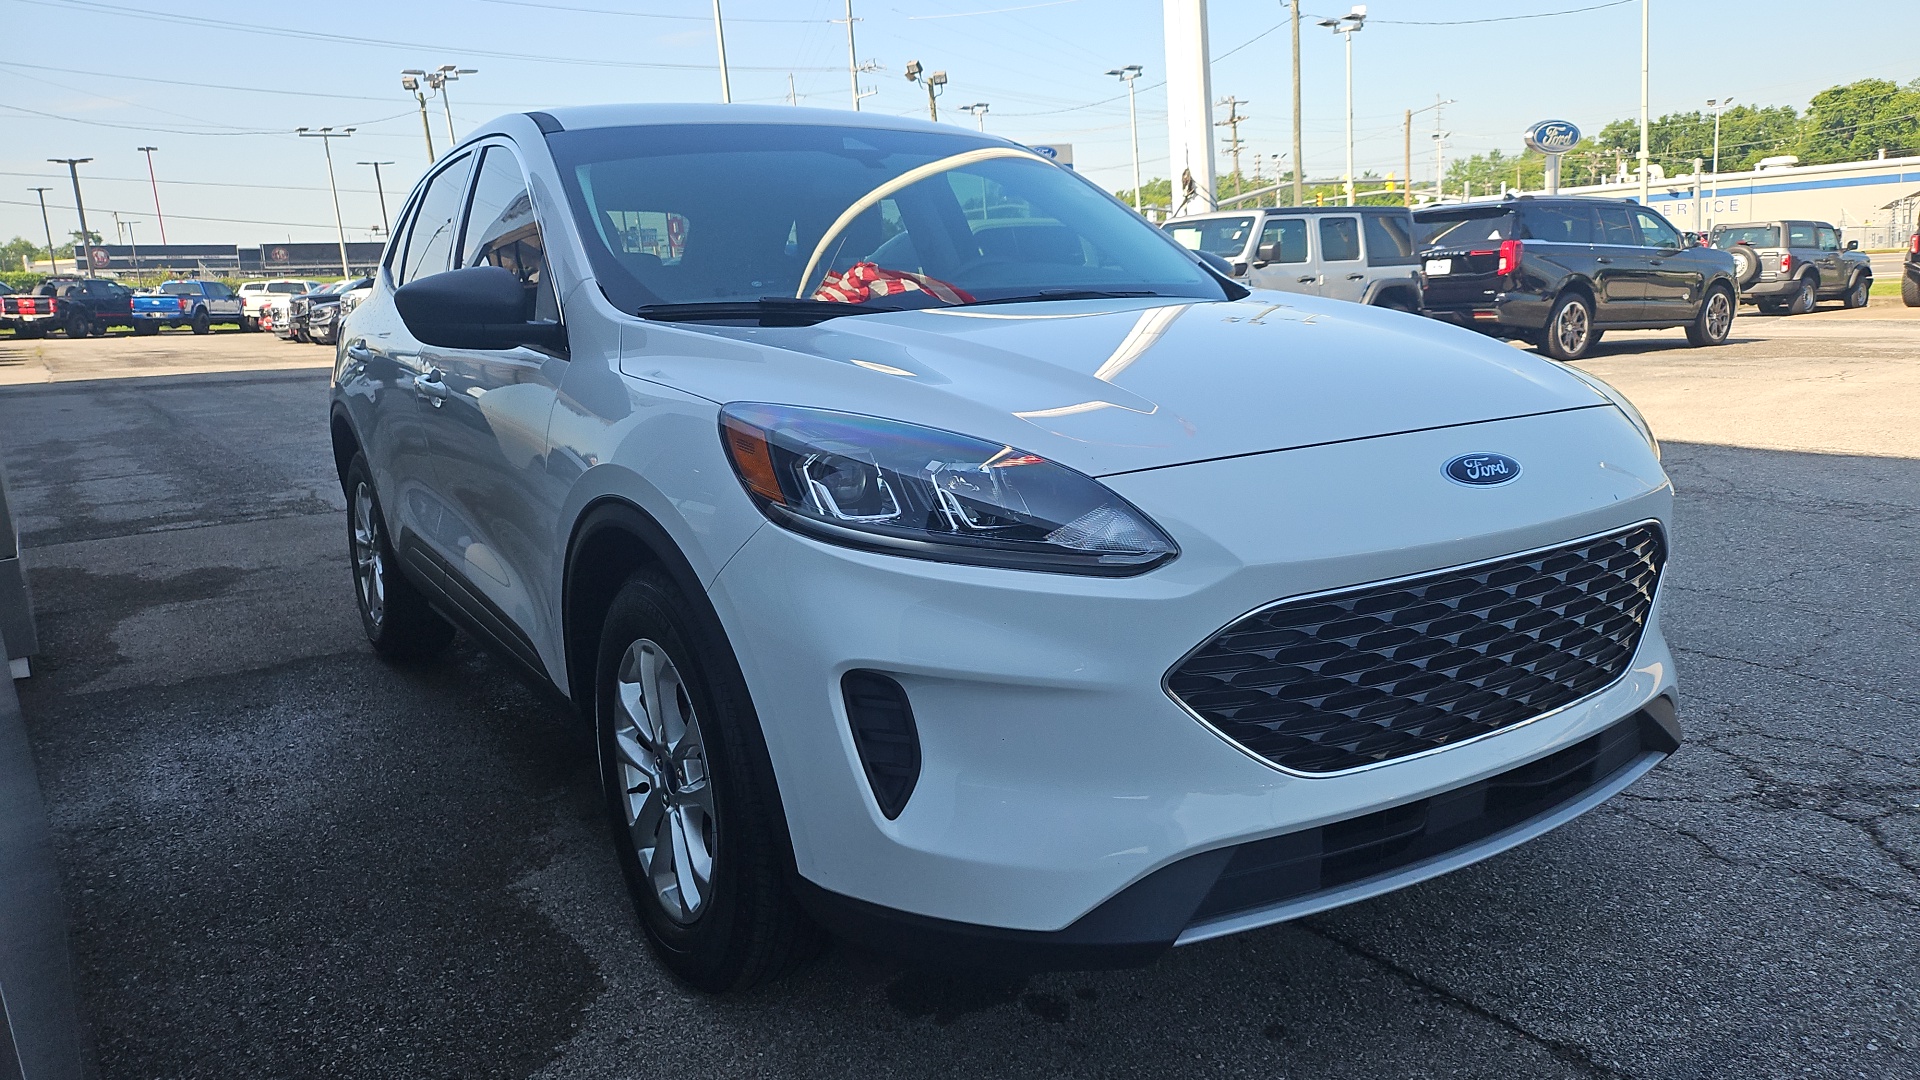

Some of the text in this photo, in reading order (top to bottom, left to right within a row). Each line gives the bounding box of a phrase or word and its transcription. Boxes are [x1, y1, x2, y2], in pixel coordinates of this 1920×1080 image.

[1542, 125, 1573, 146] Ford
[1652, 198, 1739, 216] ERICE
[1463, 457, 1509, 479] Ford
